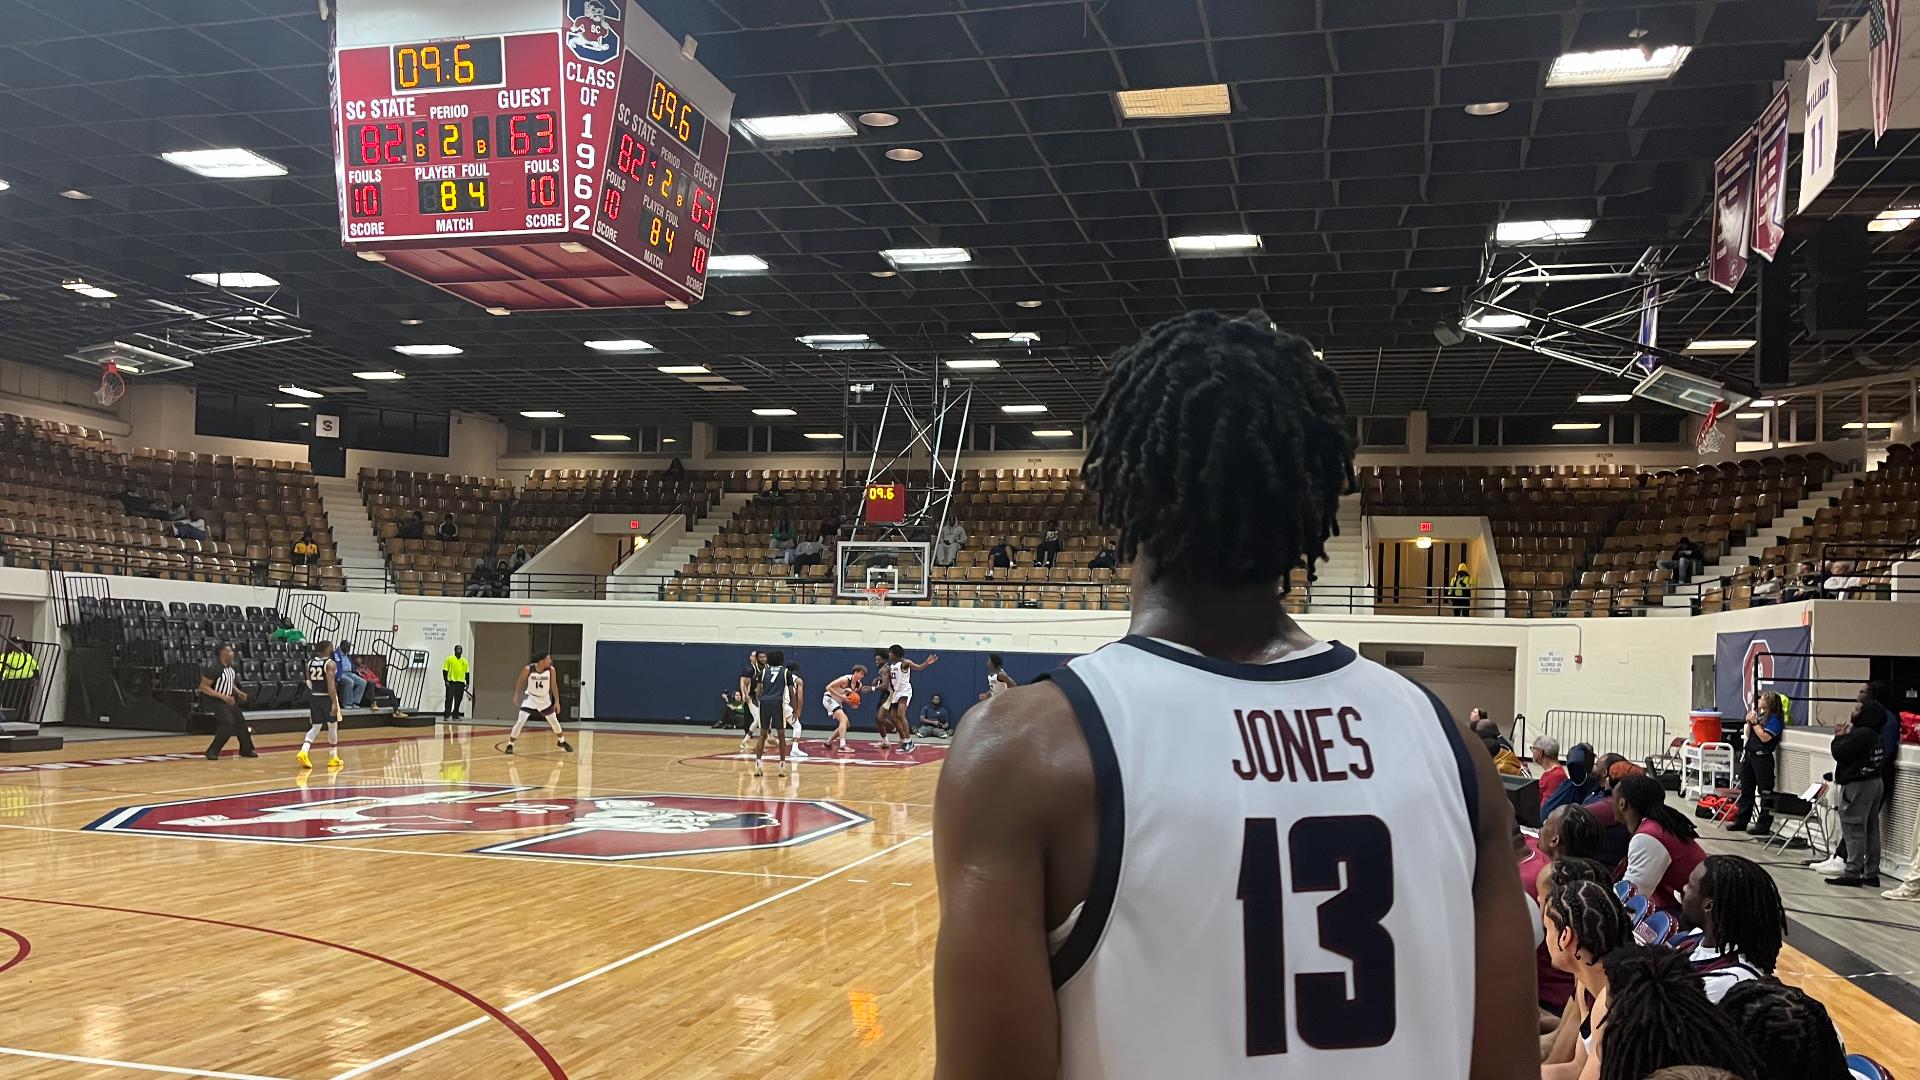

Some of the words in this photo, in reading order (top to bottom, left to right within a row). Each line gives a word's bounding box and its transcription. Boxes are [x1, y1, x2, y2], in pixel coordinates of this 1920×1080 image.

[398, 43, 475, 87] 09.6
[566, 61, 616, 90] CLASS
[497, 87, 551, 109] GUEST
[580, 86, 600, 107] OF
[346, 101, 366, 120] SC
[370, 97, 416, 118] STATE
[429, 104, 469, 119] PERIOD
[652, 82, 692, 141] 09.6
[510, 113, 553, 156] 63
[617, 103, 631, 126] SC
[631, 114, 657, 146] STATE
[360, 124, 403, 164] 82
[416, 143, 426, 157] B
[443, 124, 459, 155] 2
[476, 139, 487, 154] B
[1811, 115, 1824, 177] 11
[524, 158, 560, 174] FOULS
[617, 133, 647, 182] 82
[660, 147, 681, 169] PERIOD
[349, 169, 382, 184] FOULS
[415, 166, 456, 180] PLAYER
[461, 162, 490, 177] FOUL
[605, 168, 626, 192] FOULS
[693, 162, 718, 191] GUEST
[530, 175, 555, 206] 10
[660, 168, 673, 198] 2
[354, 185, 378, 215] 10
[604, 188, 621, 220] 10
[643, 194, 664, 216] PLAYER
[665, 209, 679, 228] FOUL
[691, 187, 715, 230] 63
[350, 221, 385, 236] SCORE
[435, 217, 474, 232] MATCH
[525, 213, 562, 228] SCORE
[596, 220, 618, 243] SCORE
[694, 229, 710, 249] FOULS
[643, 249, 664, 270] MATCH
[691, 246, 706, 274] 10
[685, 274, 703, 294] SCORE
[869, 487, 895, 500] 09.6
[310, 667, 324, 680] 22
[770, 671, 779, 683] 7
[1232, 706, 1375, 783] JONES
[1236, 814, 1397, 1057] 13
